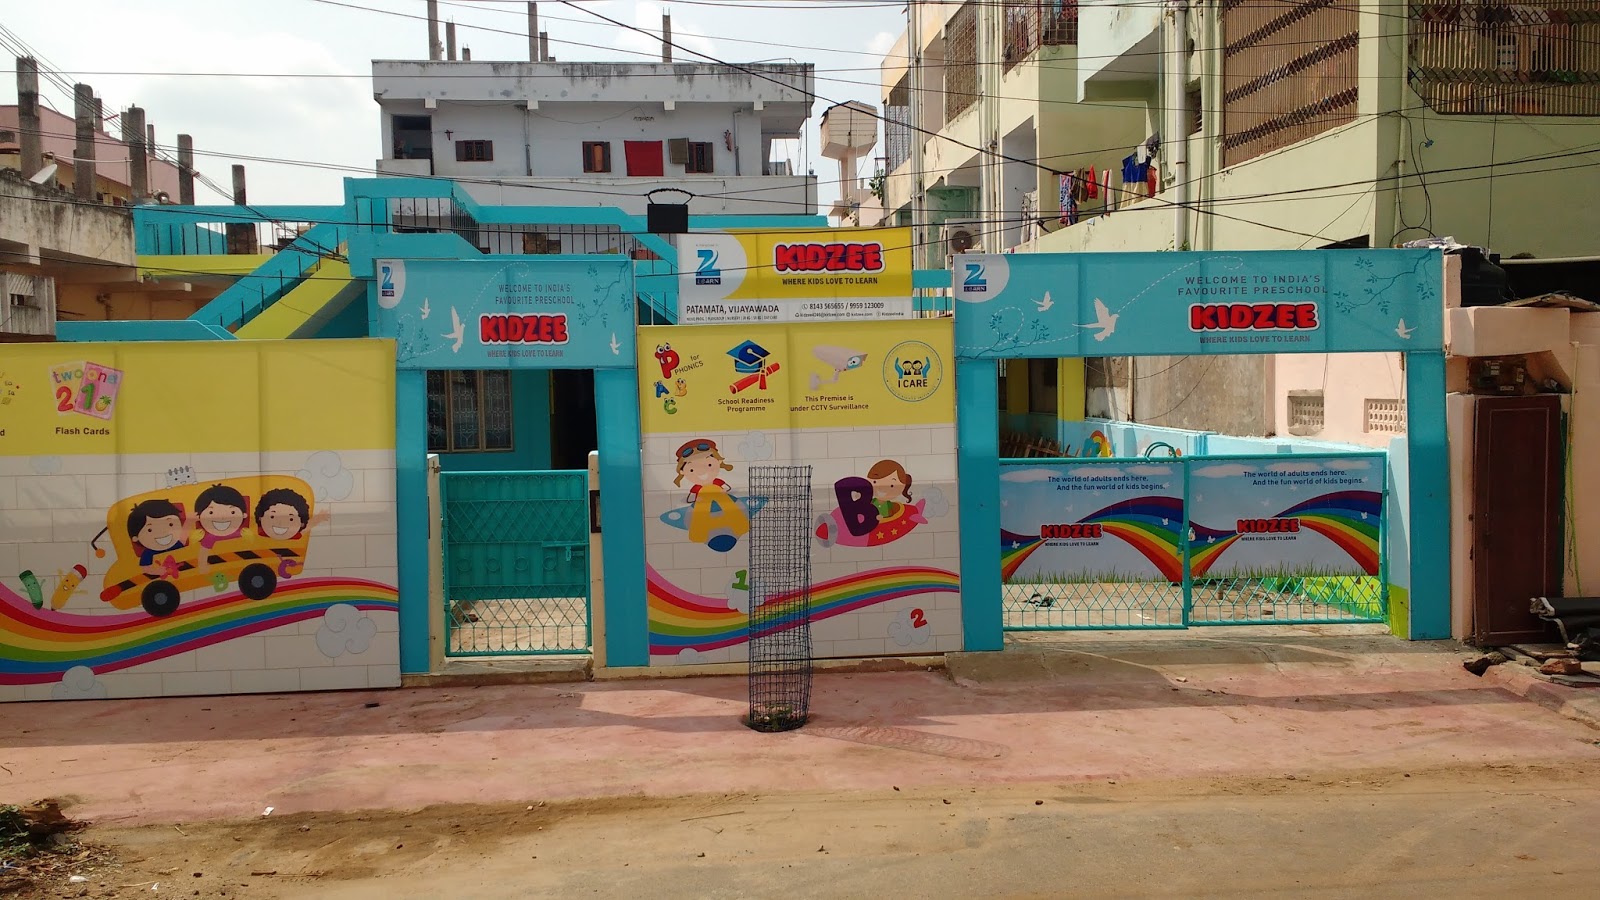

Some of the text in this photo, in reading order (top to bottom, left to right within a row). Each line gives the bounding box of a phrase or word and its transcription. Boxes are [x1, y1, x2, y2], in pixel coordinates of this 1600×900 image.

[775, 243, 883, 271] KIDZEE
[1184, 274, 1321, 285] WELCOME TO INDIA'S
[499, 284, 532, 292] WELCOME
[546, 284, 570, 292] INDIA'S
[1178, 285, 1328, 296] FAVOURITE PRESCHOOL
[496, 296, 574, 304] FAVOURITE PRESCHOOL
[686, 305, 779, 315] PATAMATA, VIJAYAWADA
[1191, 304, 1317, 330] KIDZEE
[481, 316, 568, 343] KIDZEE
[674, 360, 704, 375] PHONICS
[903, 379, 928, 388] CARE
[56, 386, 73, 412] 2
[81, 383, 95, 409] 1
[1141, 483, 1166, 491] begins.
[1322, 477, 1337, 485] kids
[1338, 477, 1364, 485] begins.
[834, 476, 880, 536] B
[1041, 524, 1102, 539] KIDZEE
[1238, 518, 1299, 533] KIDZEE
[732, 569, 749, 591] 1
[910, 608, 927, 628] 2
